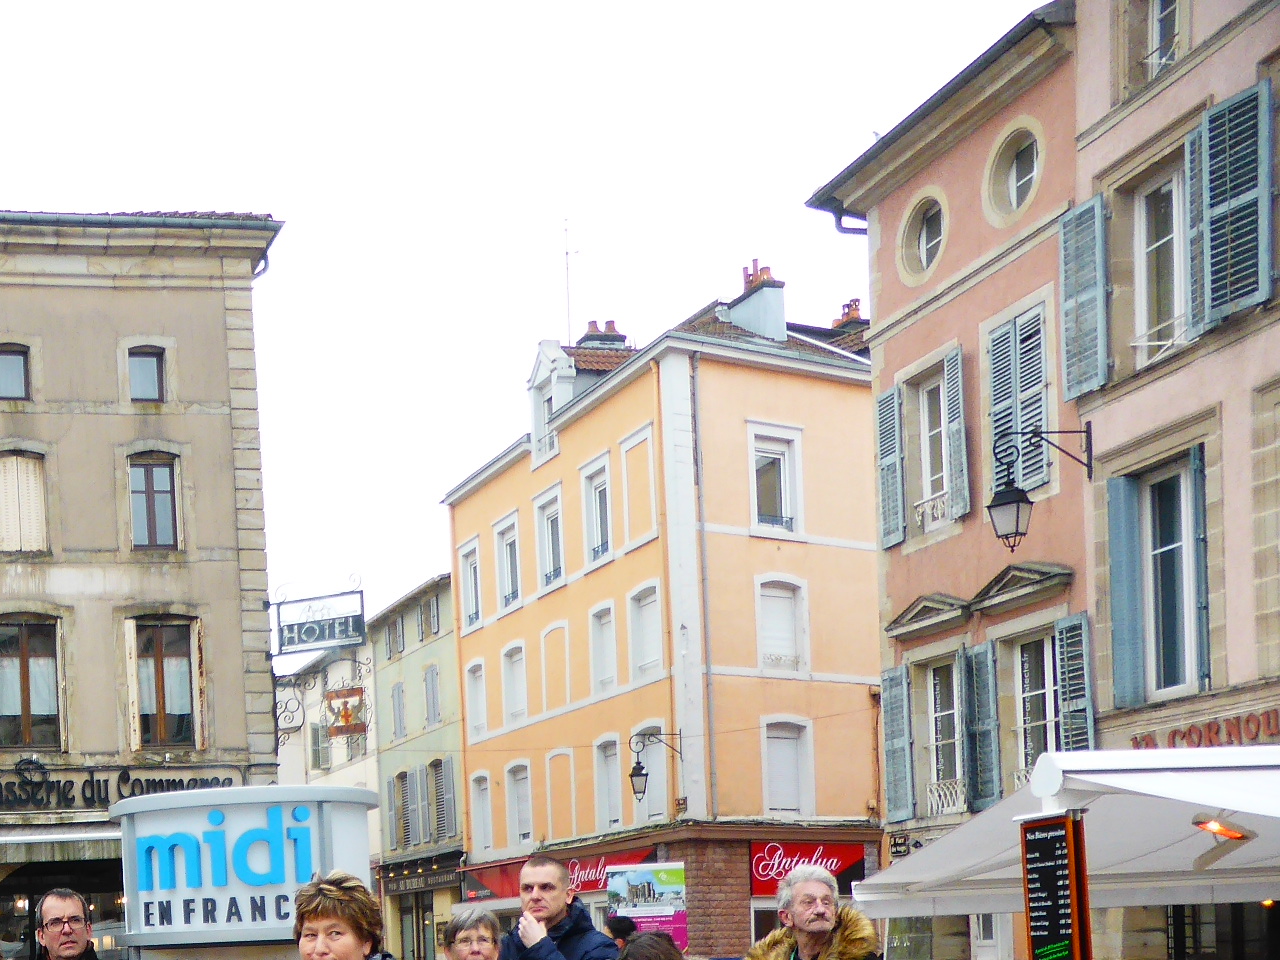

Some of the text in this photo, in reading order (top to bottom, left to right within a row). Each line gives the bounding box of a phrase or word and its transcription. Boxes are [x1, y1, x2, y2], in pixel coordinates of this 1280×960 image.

[283, 616, 360, 646] HOTEL
[82, 769, 110, 808] du
[136, 805, 313, 892] midi
[567, 857, 607, 891] Antaly
[144, 894, 290, 927] EN FRANC
